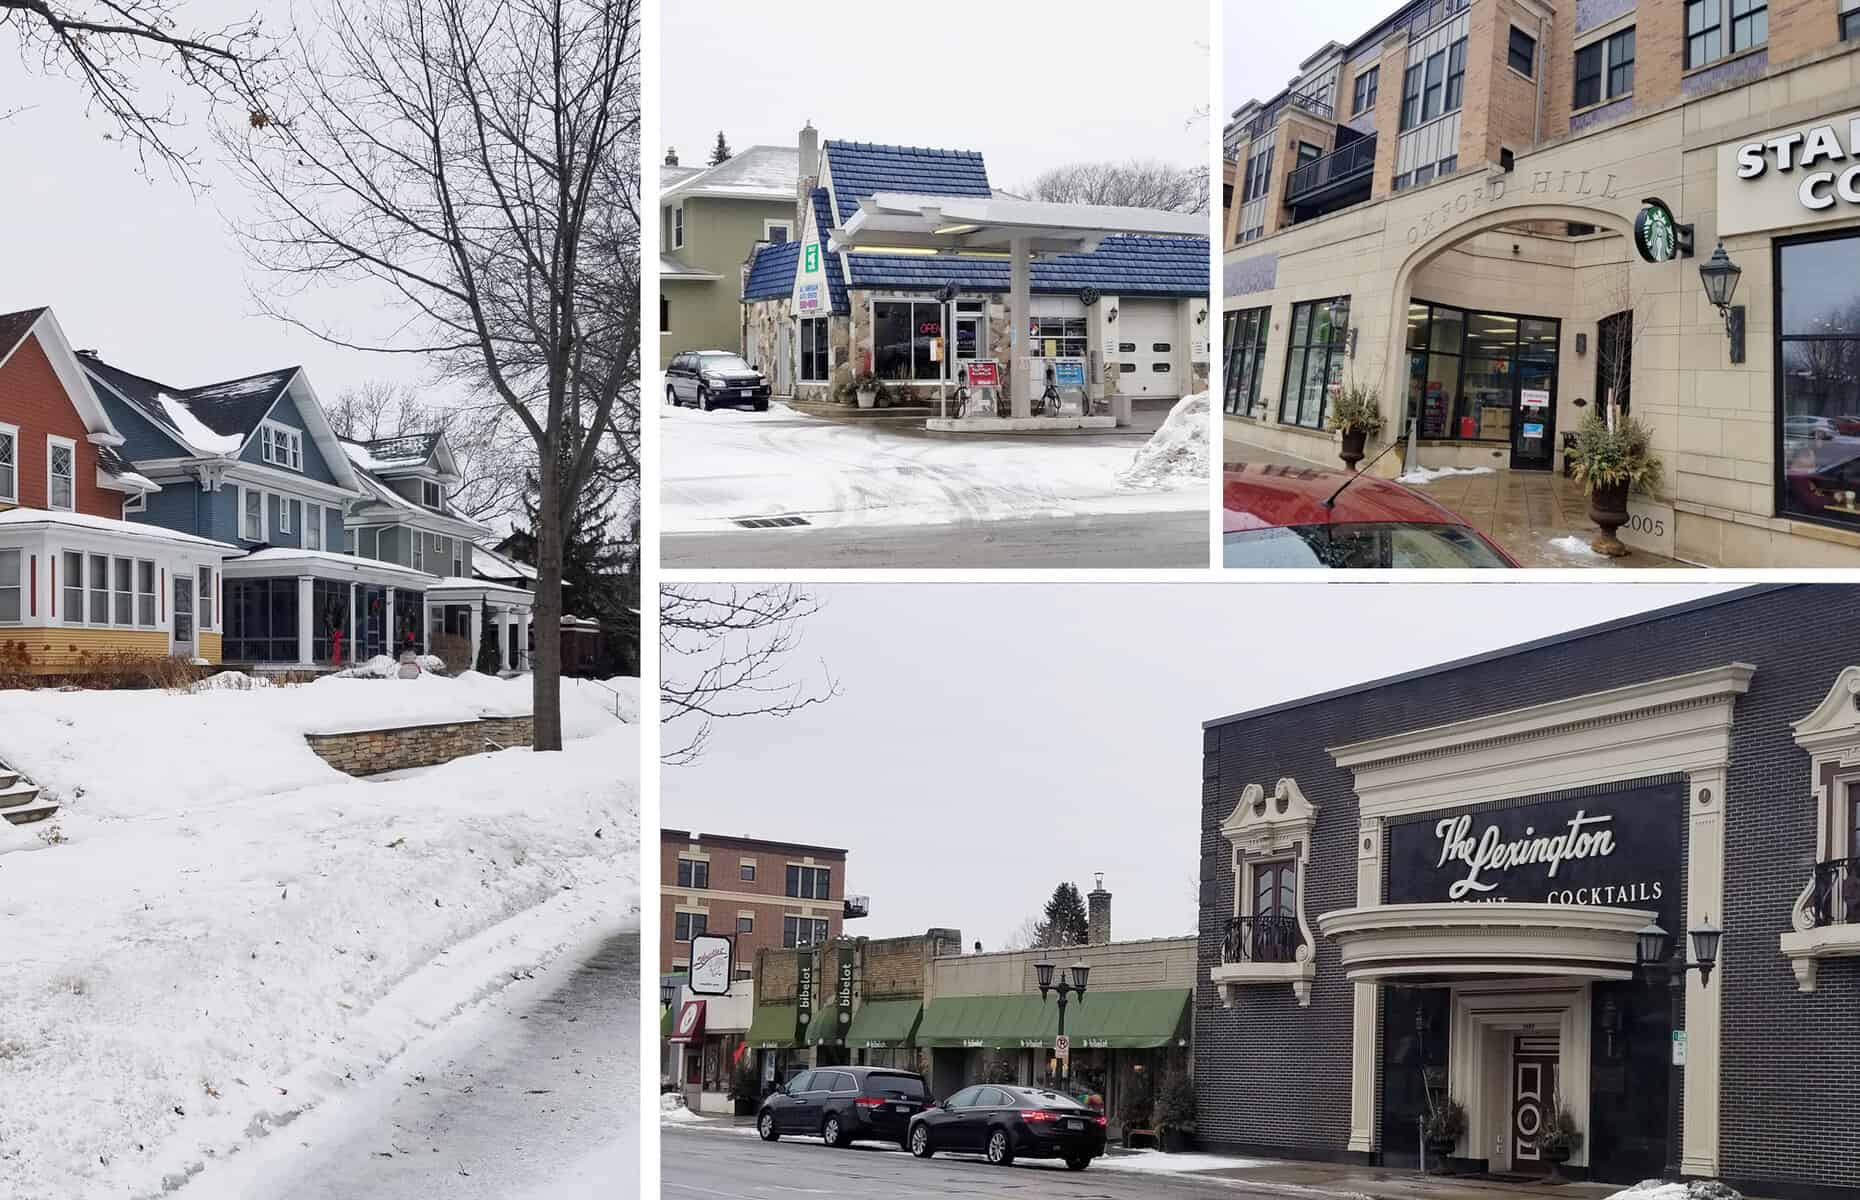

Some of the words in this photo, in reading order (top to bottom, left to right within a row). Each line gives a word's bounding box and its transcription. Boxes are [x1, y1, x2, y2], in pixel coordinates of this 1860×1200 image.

[1407, 177, 1505, 244] OXFORD
[1530, 170, 1617, 200] HILL
[1623, 514, 1665, 537] 005
[1435, 814, 1477, 868] The
[1449, 810, 1616, 899] Lexington
[1547, 881, 1663, 905] COCKTAILS
[799, 967, 811, 1008] bibelot
[839, 963, 852, 1007] bibelot
